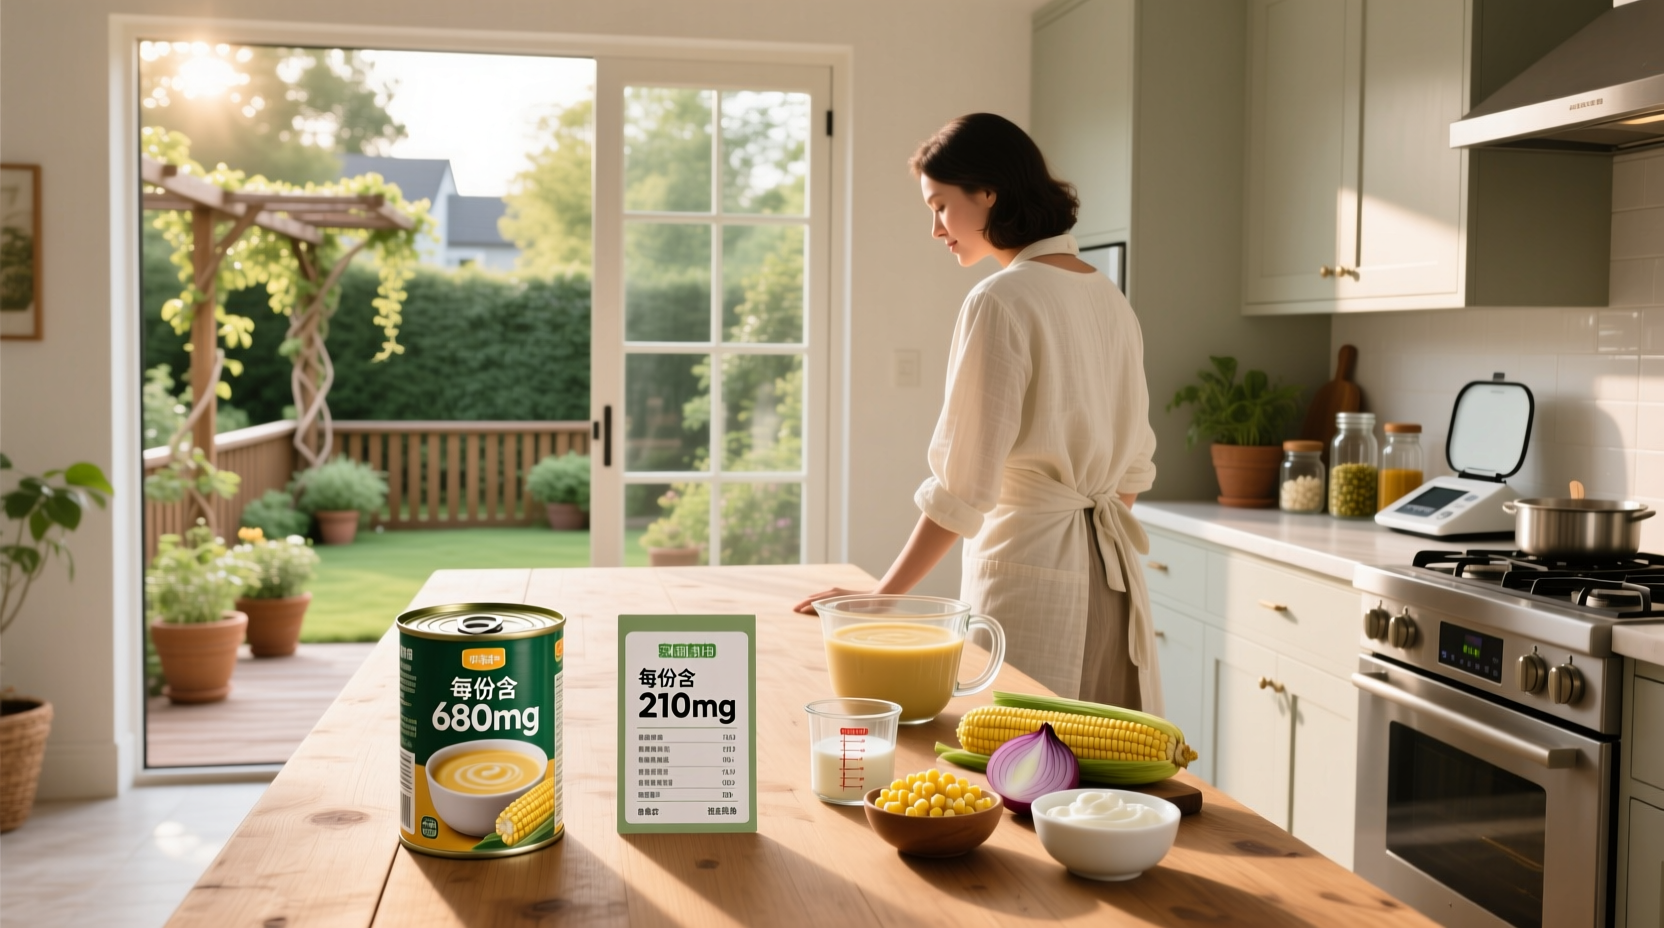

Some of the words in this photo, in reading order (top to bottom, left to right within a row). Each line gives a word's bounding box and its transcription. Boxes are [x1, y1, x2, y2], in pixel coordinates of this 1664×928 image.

[449, 676, 518, 701] 每份含
[638, 667, 696, 688] 每份含
[432, 701, 540, 736] 680mg
[638, 691, 736, 725] 210mg
